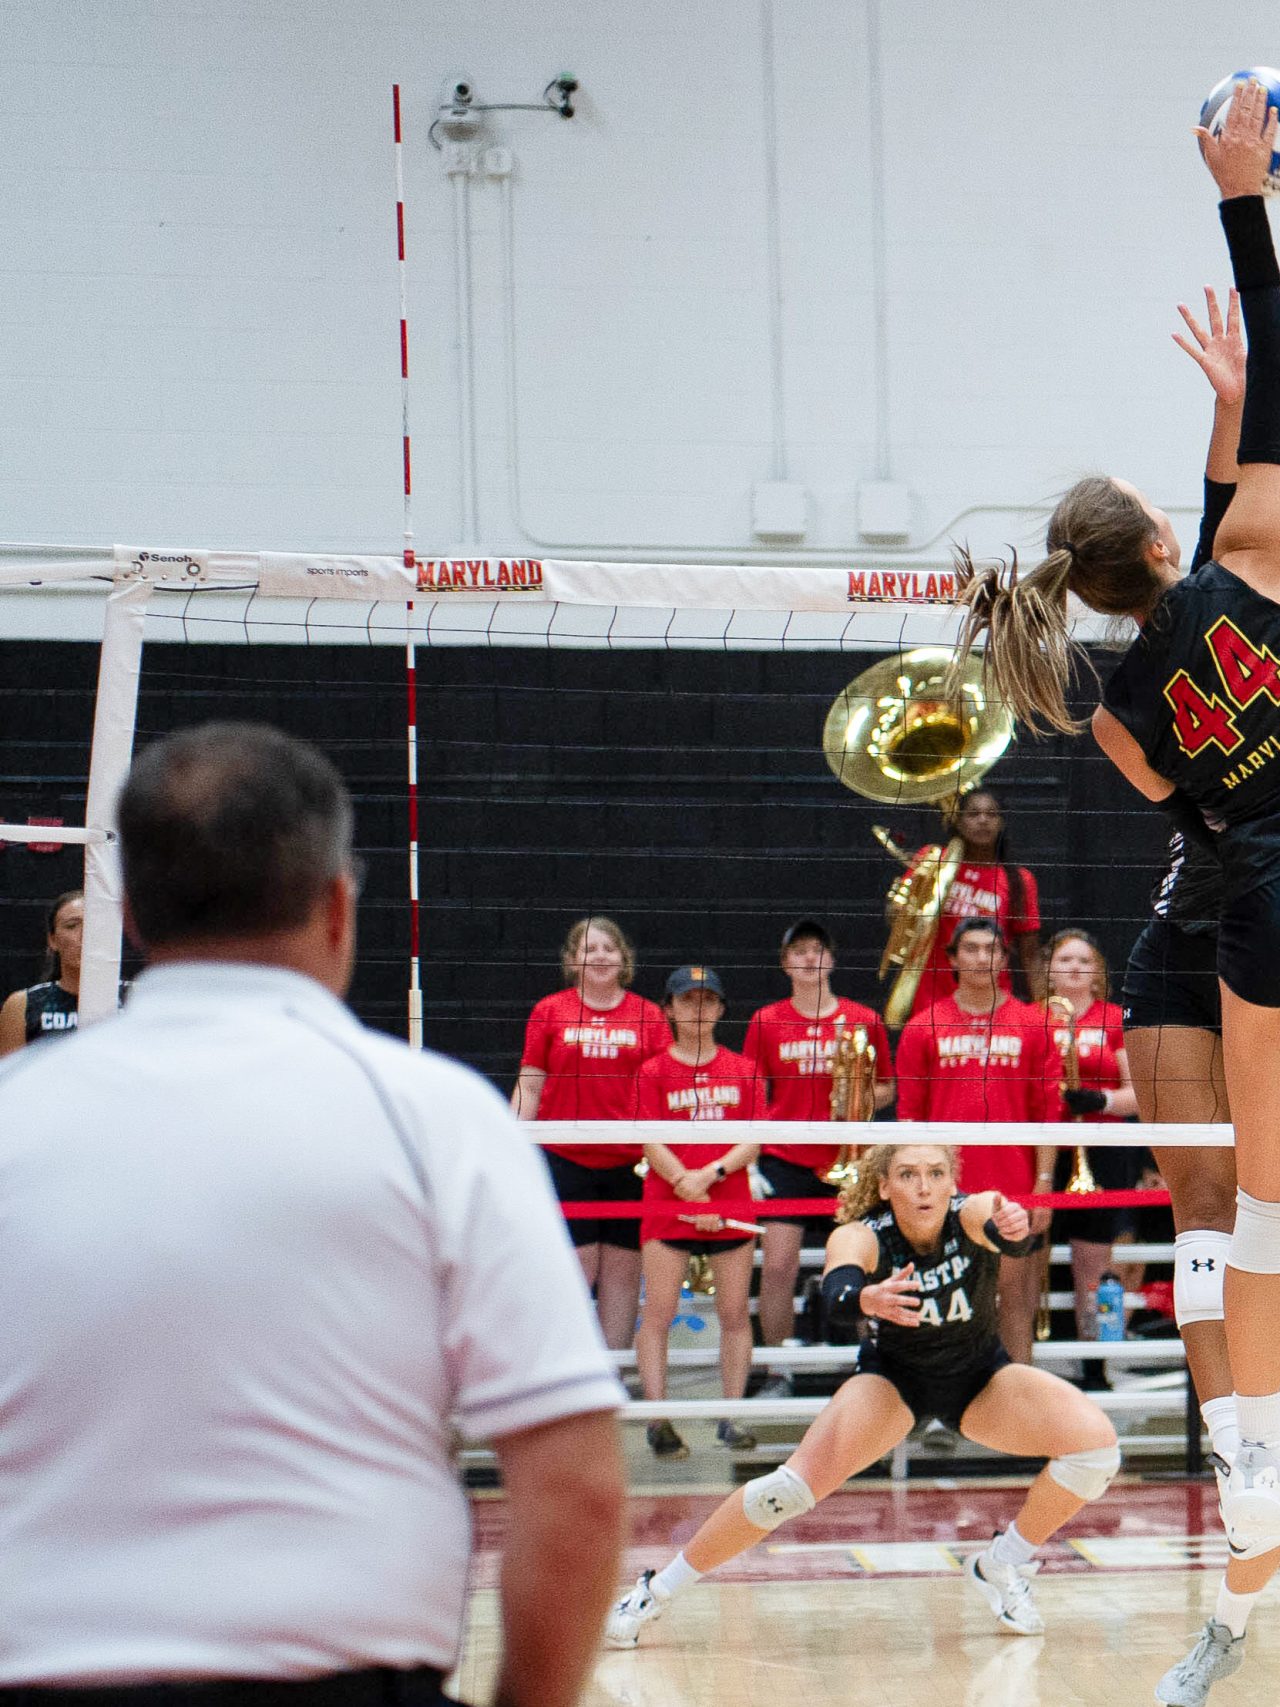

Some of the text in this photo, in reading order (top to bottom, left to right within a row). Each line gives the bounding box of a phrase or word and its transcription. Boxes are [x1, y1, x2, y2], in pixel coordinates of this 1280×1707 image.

[151, 554, 192, 563] Senoh
[307, 567, 369, 577] sports imports
[416, 559, 543, 587] MARYLAND
[848, 571, 960, 599] MARYLAN
[919, 1287, 974, 1326] 44
